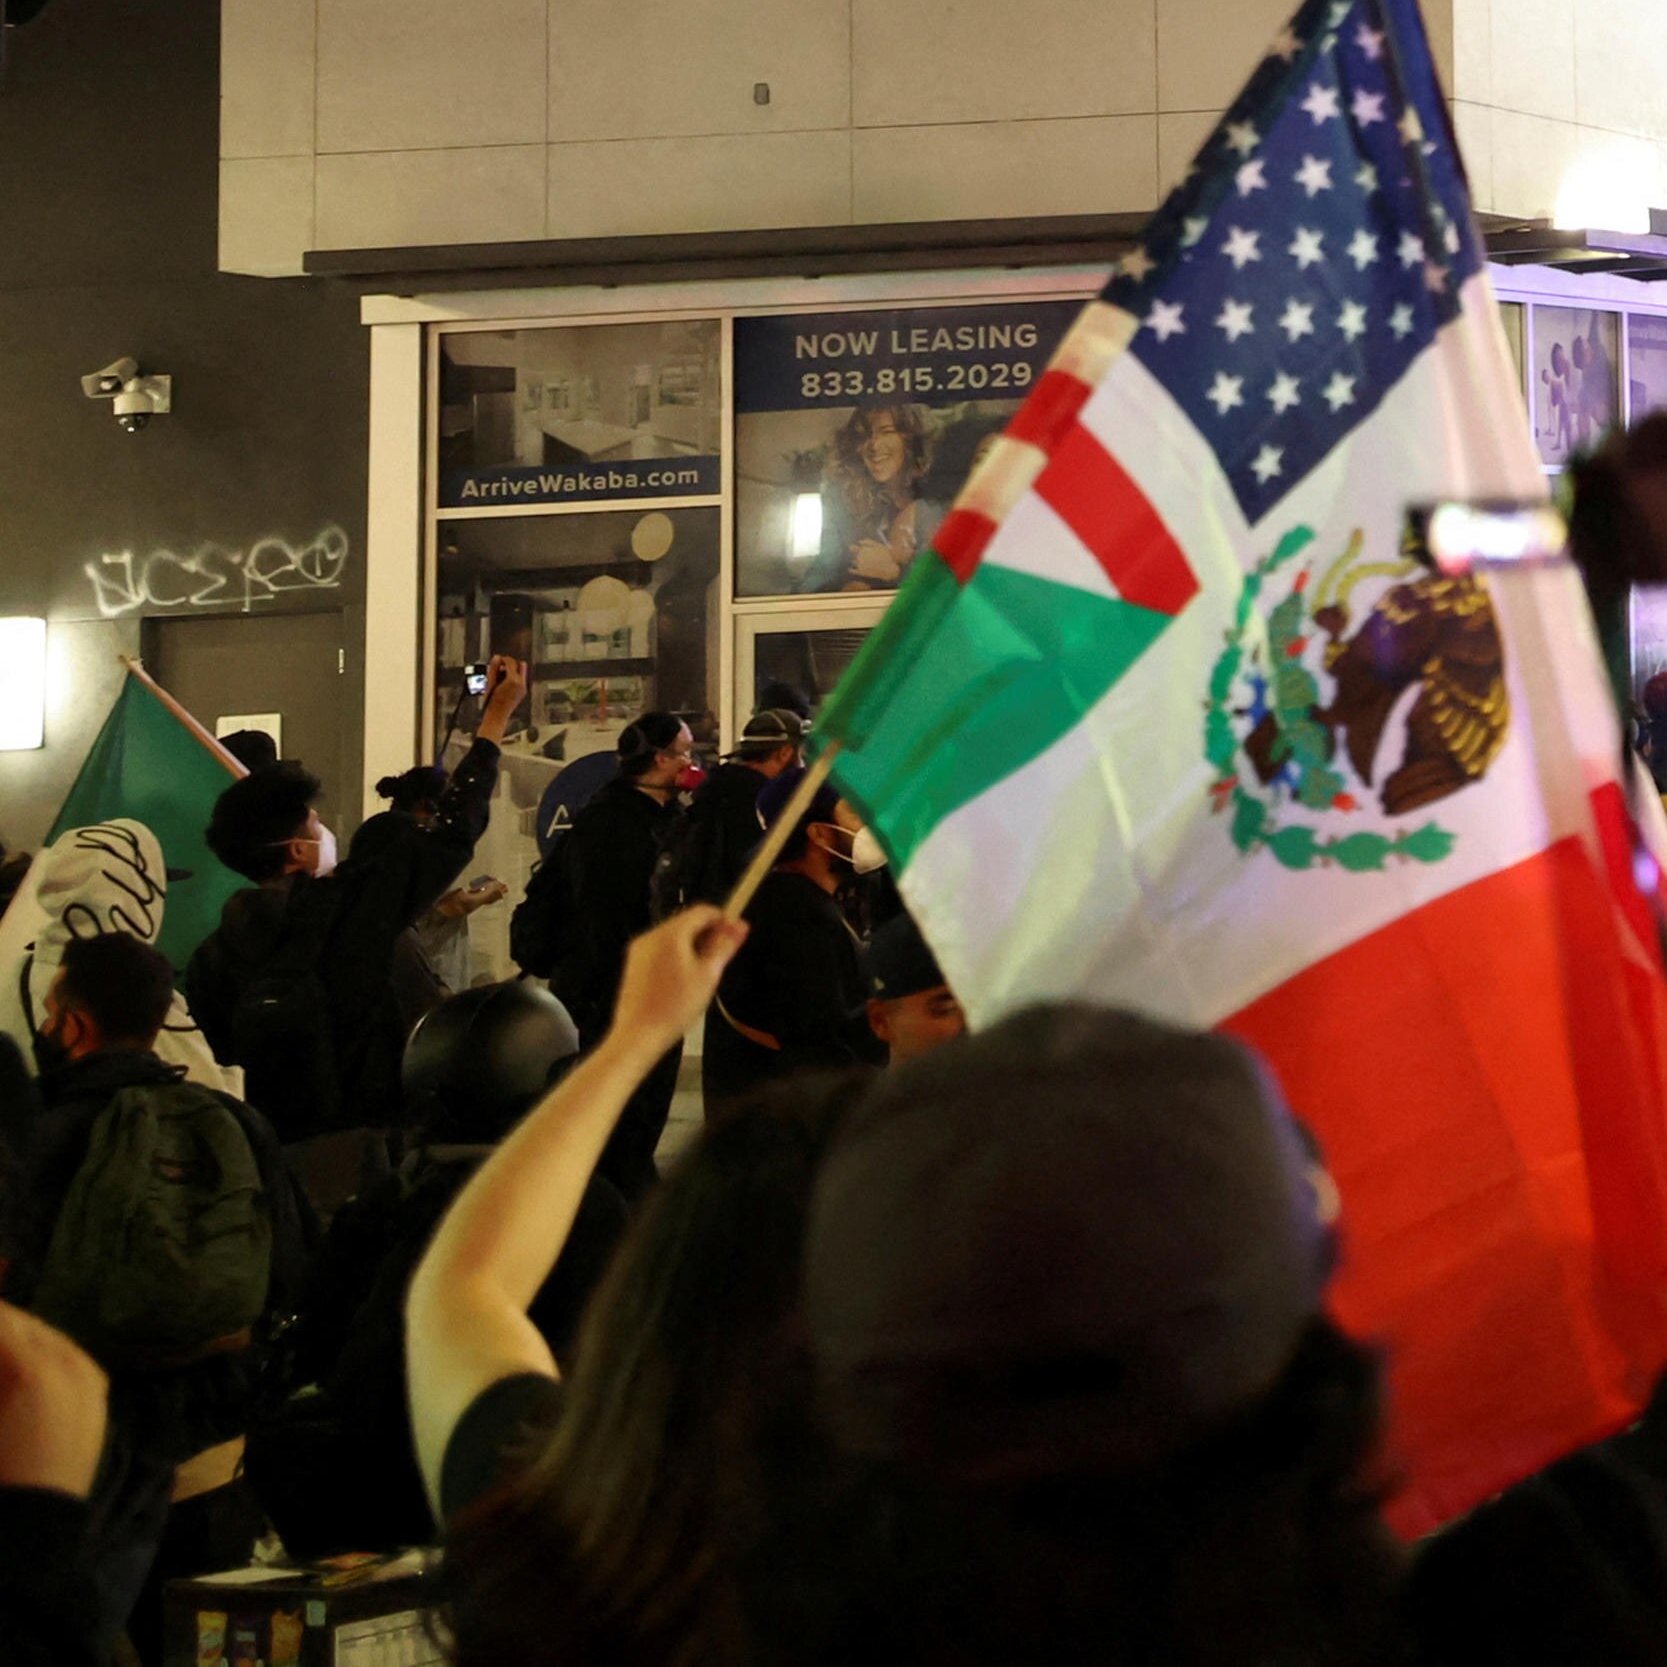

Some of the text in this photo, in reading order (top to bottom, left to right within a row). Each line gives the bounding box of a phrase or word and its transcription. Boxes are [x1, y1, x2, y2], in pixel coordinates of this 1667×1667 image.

[795, 323, 1038, 359] NOW LEASING
[801, 362, 1032, 398] 833.815.2029
[460, 469, 699, 499] ArriveWakaba.com
